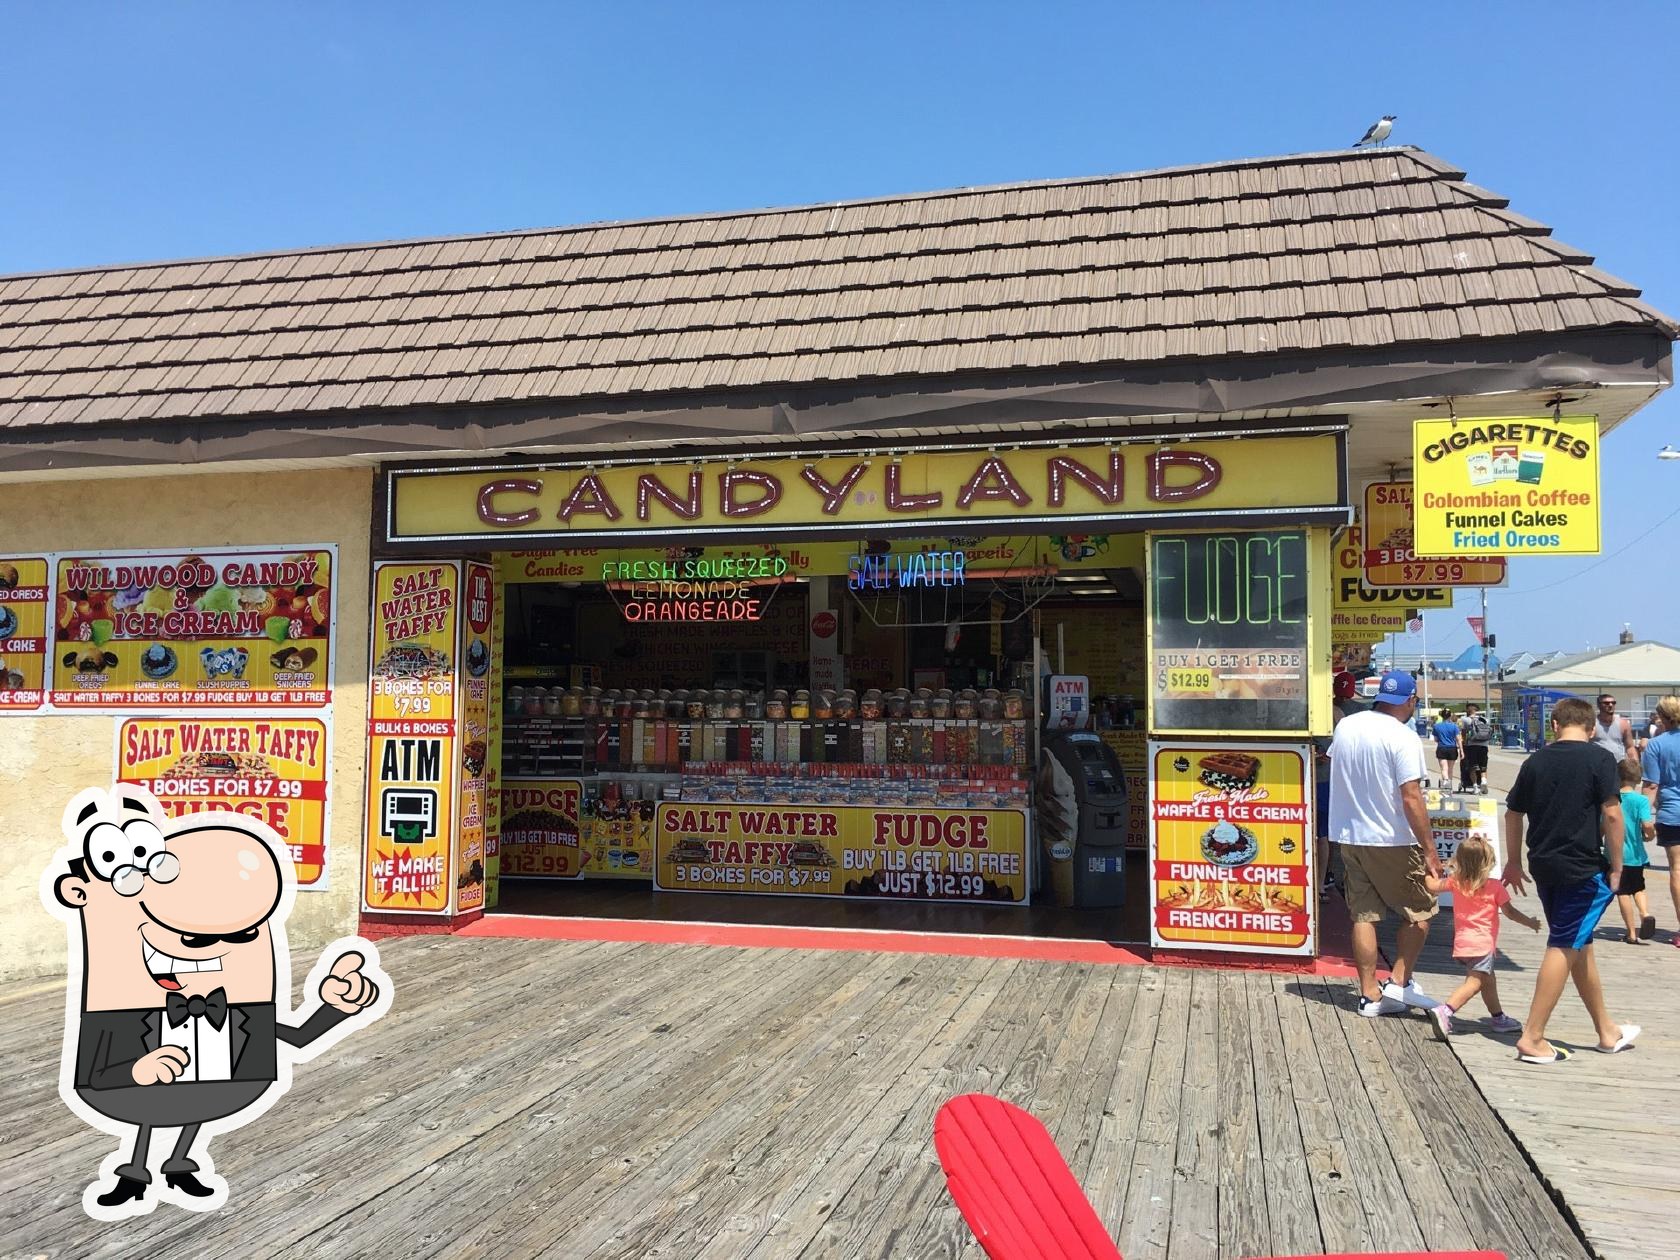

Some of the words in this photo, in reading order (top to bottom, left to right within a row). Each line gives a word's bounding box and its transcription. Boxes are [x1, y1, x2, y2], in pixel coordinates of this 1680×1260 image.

[1423, 423, 1591, 463] CIGARETTES
[478, 450, 1223, 526] CANDYLAND
[1376, 487, 1414, 504] SAL
[1424, 491, 1521, 509] Colombian
[1527, 490, 1591, 507] Coffee
[1446, 511, 1505, 528] Funnel
[1511, 510, 1568, 527] Cakes
[1454, 531, 1500, 548] Fried
[1506, 530, 1560, 547] Oreos
[1380, 551, 1390, 563] 3
[65, 561, 218, 590] WILDWOOD
[221, 560, 319, 586] CANDY
[524, 560, 585, 578] Candies
[603, 561, 677, 580] FRESH
[685, 557, 788, 578] SQUEEZED
[848, 554, 891, 590] SALT
[897, 551, 965, 588] WATER
[1403, 564, 1464, 580] $7.99
[393, 568, 442, 597] SALT
[475, 576, 487, 598] THE
[1156, 535, 1300, 625] FUDGE
[11, 589, 44, 599] OREOS
[173, 588, 189, 610] &
[631, 581, 752, 600] LEMONADE
[381, 588, 452, 621] WATER
[471, 599, 488, 623] BEST
[624, 600, 761, 621] ORANGEADE
[113, 613, 164, 636] ICE
[163, 611, 260, 636] CREAM
[385, 610, 447, 641] TAFFY
[1354, 614, 1369, 625] Ice
[1370, 613, 1402, 625] Cream
[7, 640, 36, 651] CAKE
[1158, 654, 1189, 667] BUY
[1195, 654, 1201, 667] 1
[1207, 654, 1239, 667] GET
[1245, 654, 1251, 667] 1
[1257, 654, 1300, 667] FREE
[72, 674, 91, 682] DEEP
[92, 674, 109, 682] FRIED
[134, 681, 161, 689] FUNNEL
[163, 681, 180, 689] CAKE
[197, 681, 219, 689] SLUSH
[221, 681, 250, 689] PUPPIES
[274, 673, 294, 682] DEEP
[295, 672, 315, 681] FRIED
[276, 680, 312, 689] SNICKERS
[1158, 670, 1167, 691] $
[1171, 673, 1210, 688] $12.99
[54, 692, 72, 702] SALT
[74, 692, 99, 702] WATER
[101, 692, 124, 702] TAFFY
[126, 692, 132, 702] 3
[133, 692, 160, 702] BOXES
[163, 692, 180, 702] FOR
[182, 691, 206, 702] $7.99
[207, 691, 235, 702] FUDGE
[237, 691, 254, 702] BUY
[255, 691, 269, 702] 1LB
[270, 691, 288, 702] GET
[290, 691, 303, 701] 1LB
[304, 691, 326, 701] FREE
[374, 681, 381, 695] 3
[383, 681, 425, 695] BOXES
[427, 681, 452, 695] FOR
[1056, 682, 1084, 693] ATM
[394, 697, 431, 717] $7.99
[375, 723, 401, 734] BULK
[402, 723, 411, 734] &
[412, 723, 449, 734] BOXES
[126, 724, 175, 766] SALT
[179, 724, 250, 754] WATER
[255, 724, 319, 767] TAFFY
[381, 739, 441, 781] ATM
[154, 780, 210, 796] BOXES
[214, 780, 249, 796] FOR
[254, 780, 302, 797] $7.99
[1193, 790, 1227, 807] Fresh
[1229, 788, 1269, 802] Made
[500, 790, 578, 821] FUDGE
[1157, 804, 1210, 818] WAFFLE
[1214, 804, 1225, 819] &
[1228, 805, 1249, 819] ICE
[1253, 806, 1303, 820] CREAM
[664, 809, 732, 834] SALT
[739, 812, 839, 837] WATER
[873, 813, 989, 849] FUDGE
[528, 831, 542, 843] GET
[545, 832, 557, 844] 1LB
[558, 832, 577, 847] FREE
[707, 839, 795, 866] TAFFY
[843, 849, 876, 869] BUY
[880, 850, 906, 870] 1LB
[911, 850, 944, 872] GET
[948, 852, 975, 873] 1LB
[979, 853, 1020, 875] FREE
[371, 859, 395, 877] WE
[398, 856, 445, 875] MAKE
[676, 866, 687, 881] 3
[690, 867, 746, 884] BOXES
[750, 869, 787, 886] FOR
[788, 870, 831, 887] $7.99
[1170, 863, 1238, 882] FUNNEL
[1242, 866, 1290, 884] CAKE
[373, 878, 388, 894] IT
[879, 872, 921, 894] JUST
[925, 872, 984, 897] $12.99
[1170, 911, 1237, 930] FRENCH
[1242, 912, 1294, 932] FRIES
